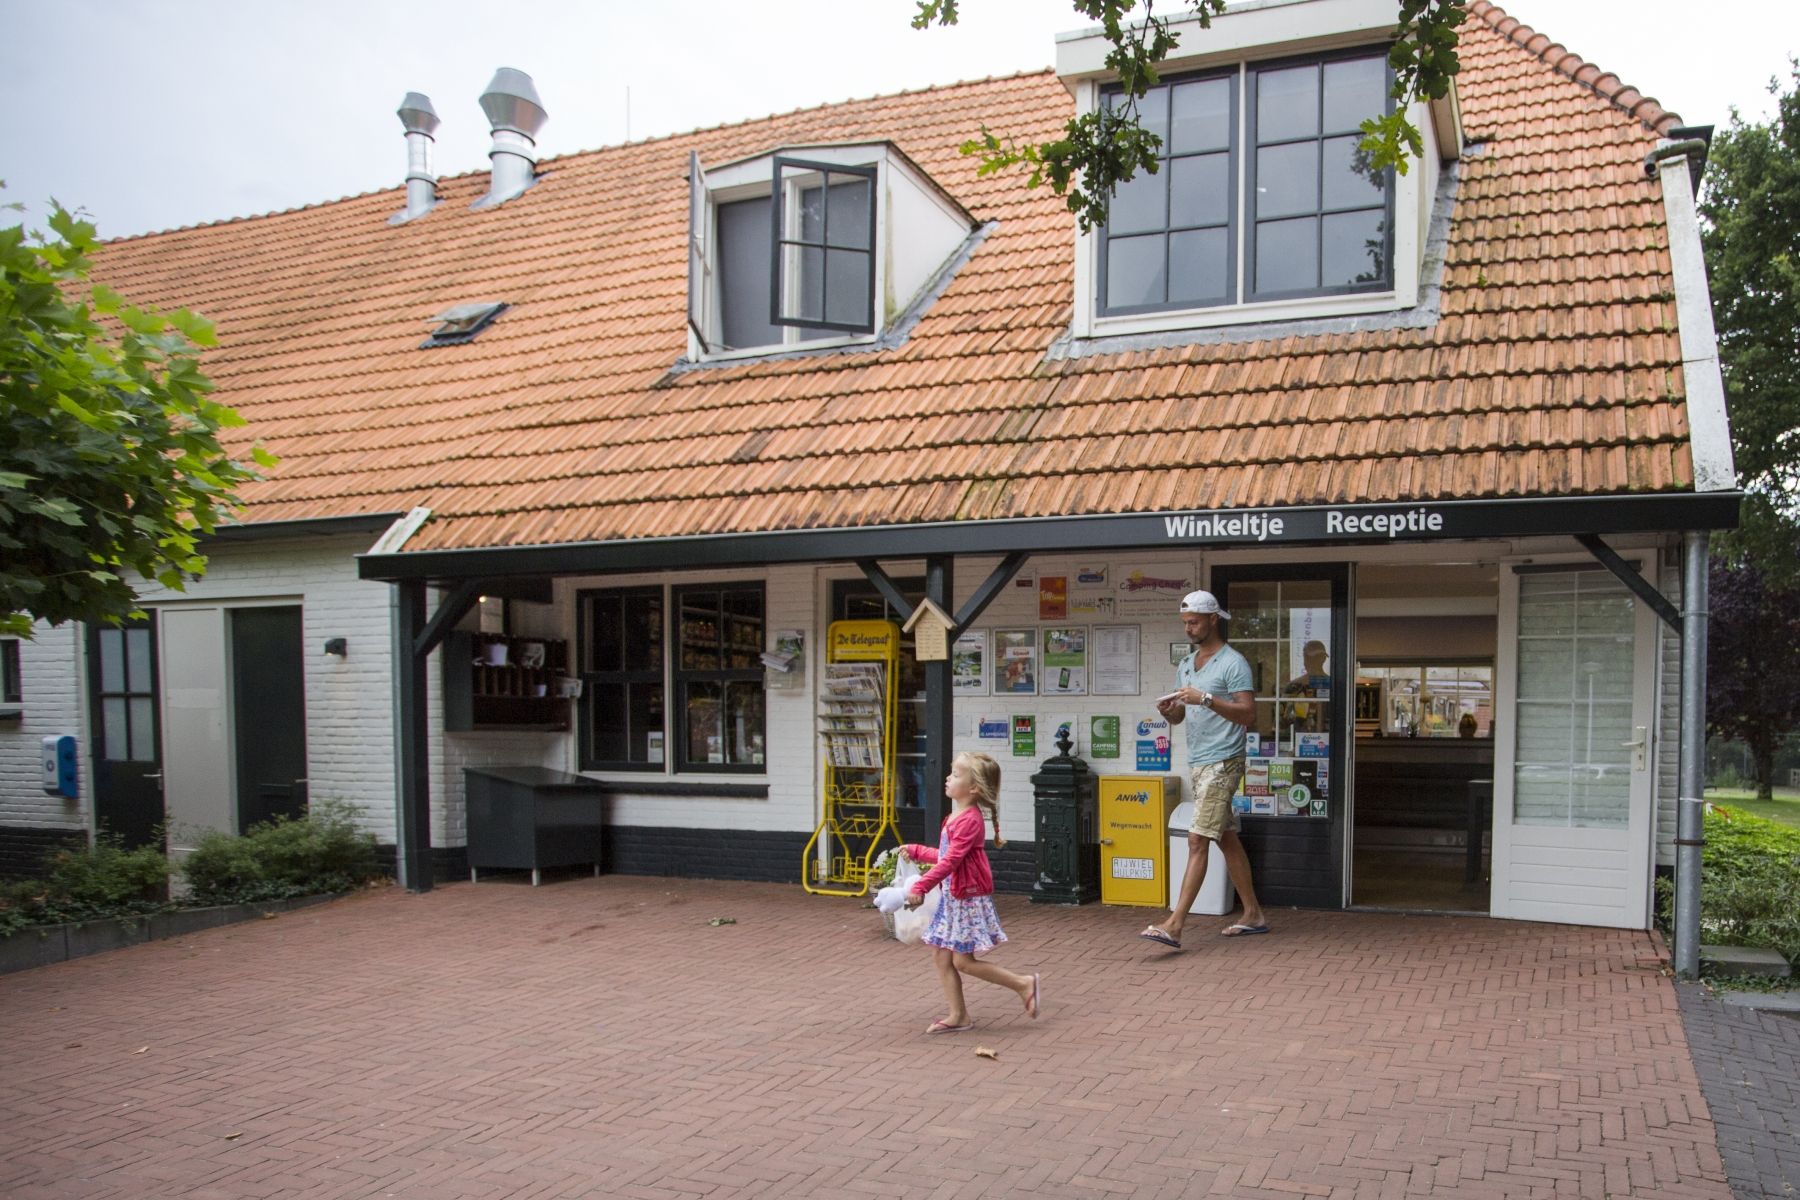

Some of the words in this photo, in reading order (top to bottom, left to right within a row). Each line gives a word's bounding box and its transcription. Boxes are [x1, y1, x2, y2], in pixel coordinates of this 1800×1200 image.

[1164, 512, 1284, 542] Winkeltje
[1326, 508, 1443, 537] Receptie
[837, 633, 850, 645] De
[850, 632, 890, 647] Telegraaf
[1143, 720, 1168, 729] anwb
[1271, 765, 1291, 774] 2014
[1246, 786, 1268, 794] 2015
[1110, 821, 1152, 830] Wegenwacht
[1113, 858, 1152, 869] RIJWIEL
[1113, 868, 1152, 879] HULPKIST
